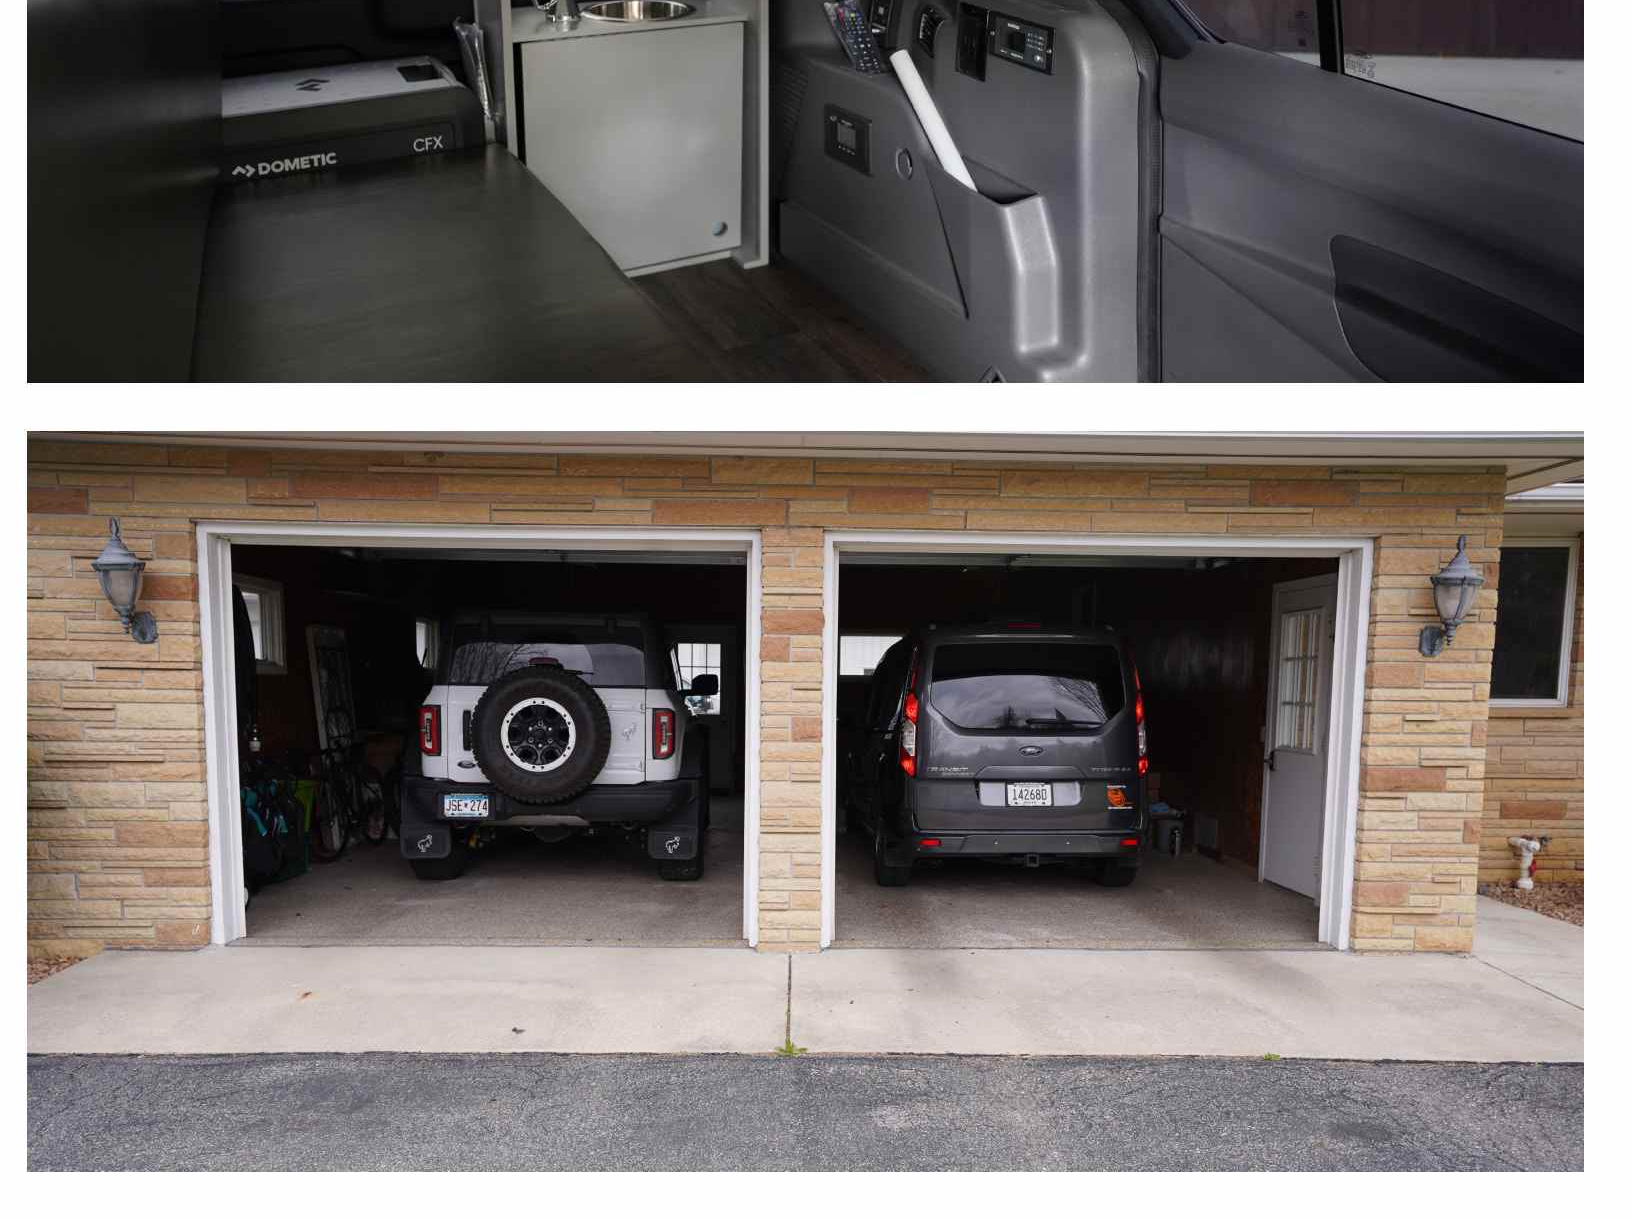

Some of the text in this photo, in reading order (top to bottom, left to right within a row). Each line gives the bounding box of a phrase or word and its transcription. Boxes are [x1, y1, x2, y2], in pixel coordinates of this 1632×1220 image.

[413, 135, 444, 152] CFX
[258, 152, 337, 176] DOMETIC
[446, 799, 488, 812] JSE 274
